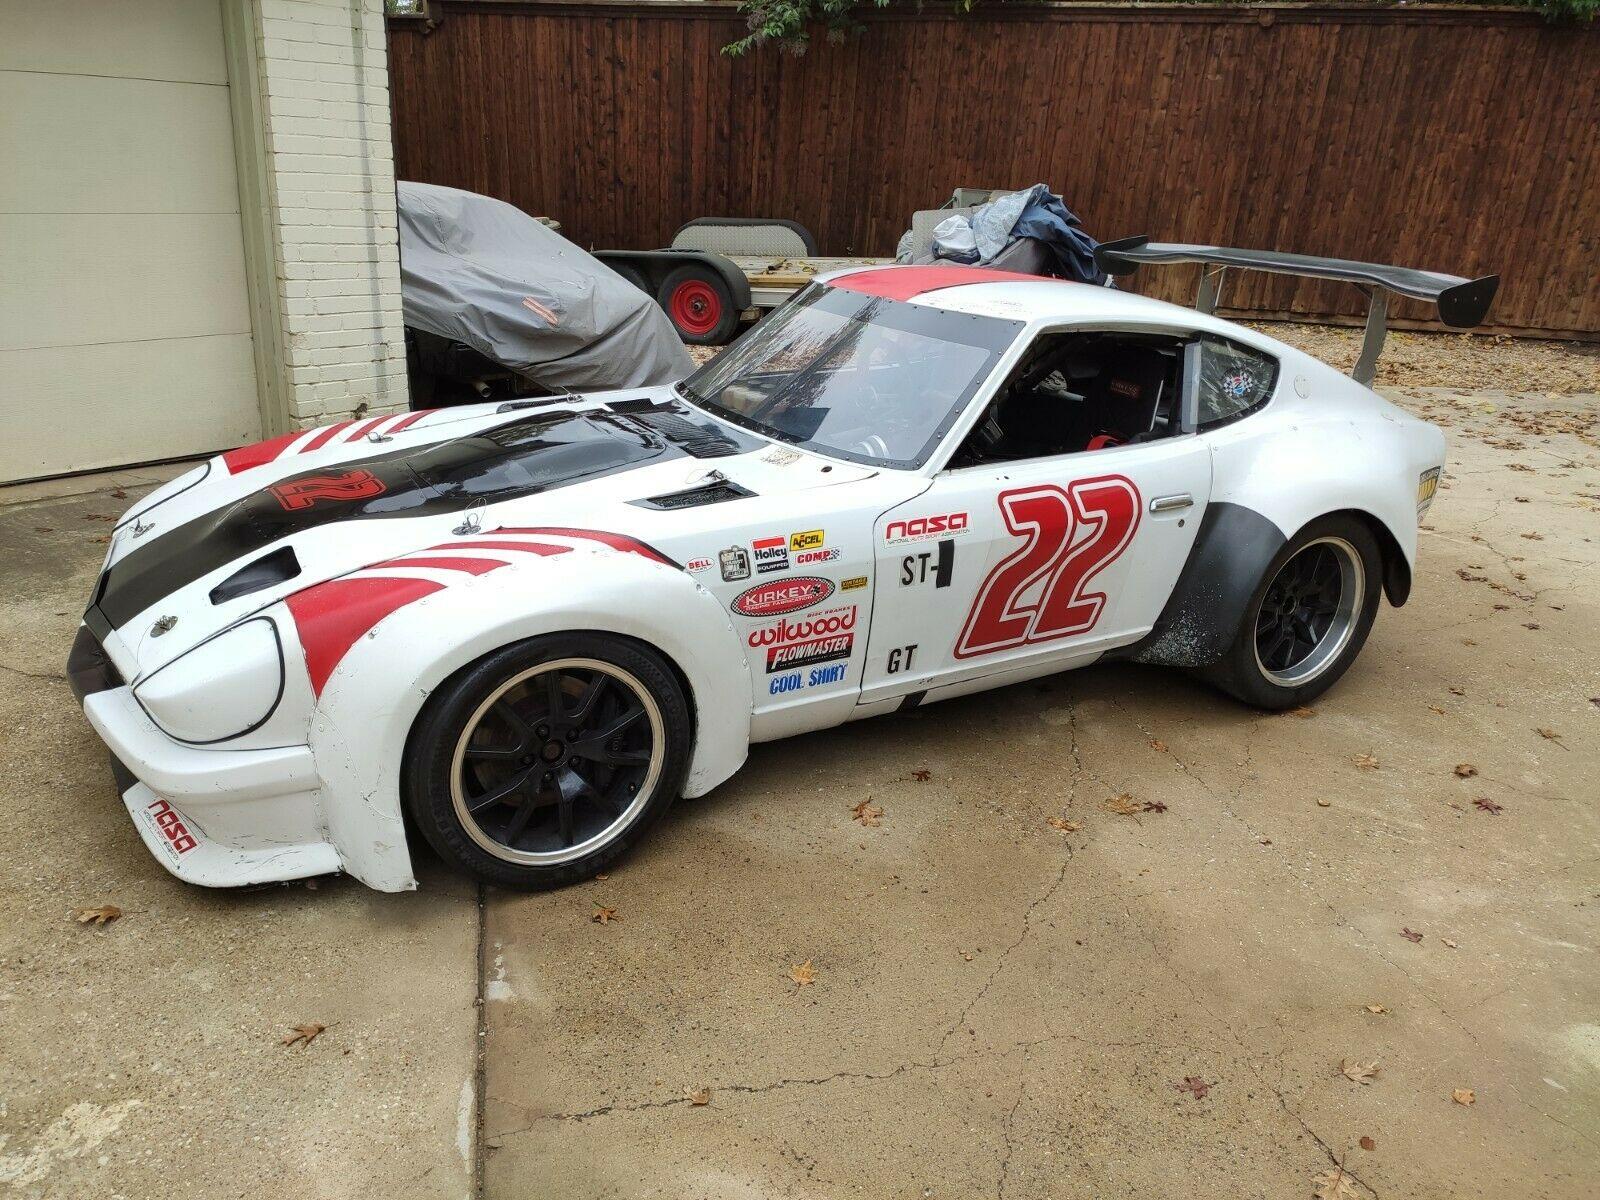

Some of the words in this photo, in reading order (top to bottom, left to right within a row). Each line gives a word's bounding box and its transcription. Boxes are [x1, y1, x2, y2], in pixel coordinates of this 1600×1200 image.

[688, 560, 711, 569] BELL
[754, 548, 787, 560] Holley
[797, 550, 831, 563] COMP
[953, 473, 1142, 660] 22
[746, 584, 811, 606] KIRKEY
[748, 606, 856, 648] wilwood
[771, 636, 850, 670] FLOWMASTER
[887, 644, 918, 674] GT
[769, 673, 804, 695] COOL
[809, 663, 849, 687] SHIRT
